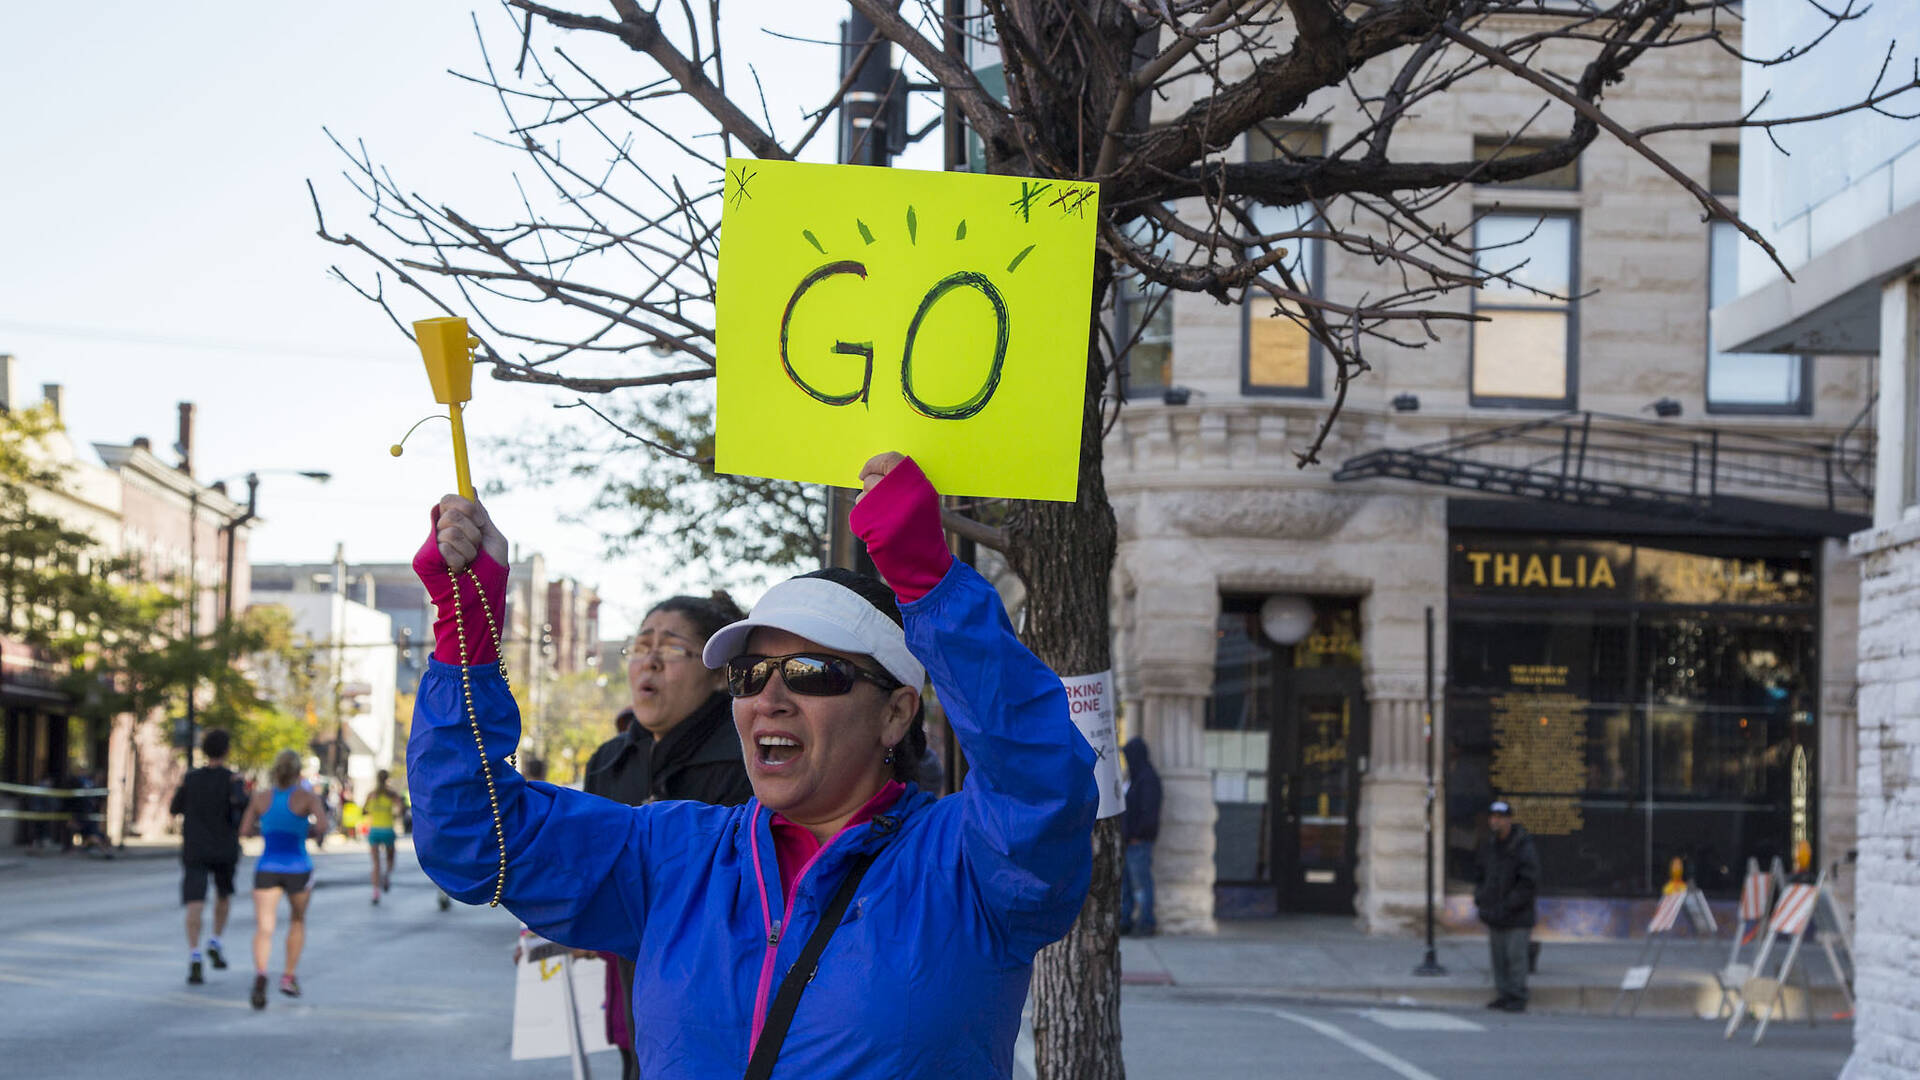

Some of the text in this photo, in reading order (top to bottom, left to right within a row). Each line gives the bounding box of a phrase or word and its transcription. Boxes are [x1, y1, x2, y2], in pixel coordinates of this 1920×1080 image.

[780, 260, 1010, 420] GO
[1467, 553, 1777, 592] THALIA HALL
[1065, 682, 1103, 698] RKING
[1070, 698, 1101, 714] ONE
